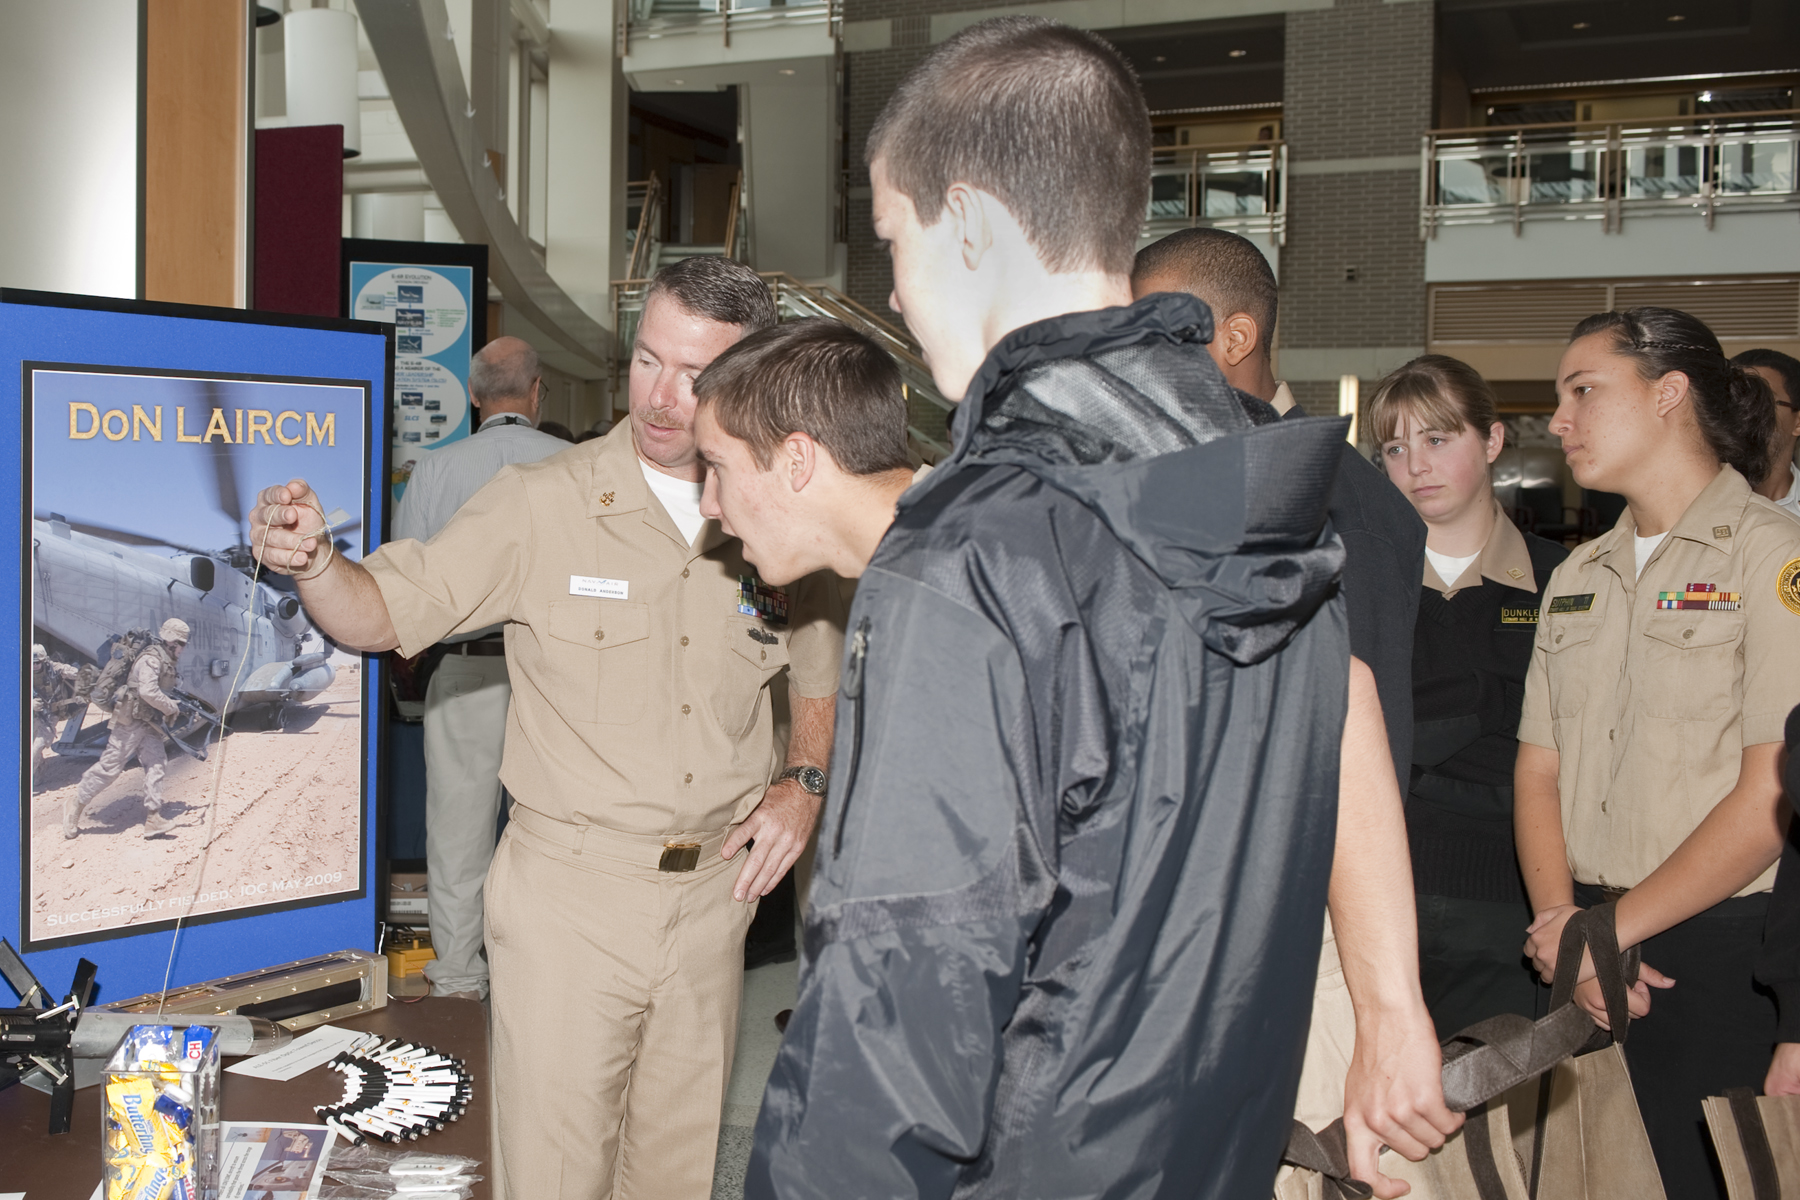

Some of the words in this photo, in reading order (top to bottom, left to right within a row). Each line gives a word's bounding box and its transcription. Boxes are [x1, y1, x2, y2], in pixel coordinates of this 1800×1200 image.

[69, 402, 162, 441] DoN
[176, 407, 336, 447] LAIRCM
[46, 901, 164, 926] SUCCESSFULLY
[241, 882, 268, 896] IOC
[272, 879, 302, 892] MAY
[304, 872, 342, 887] 2009
